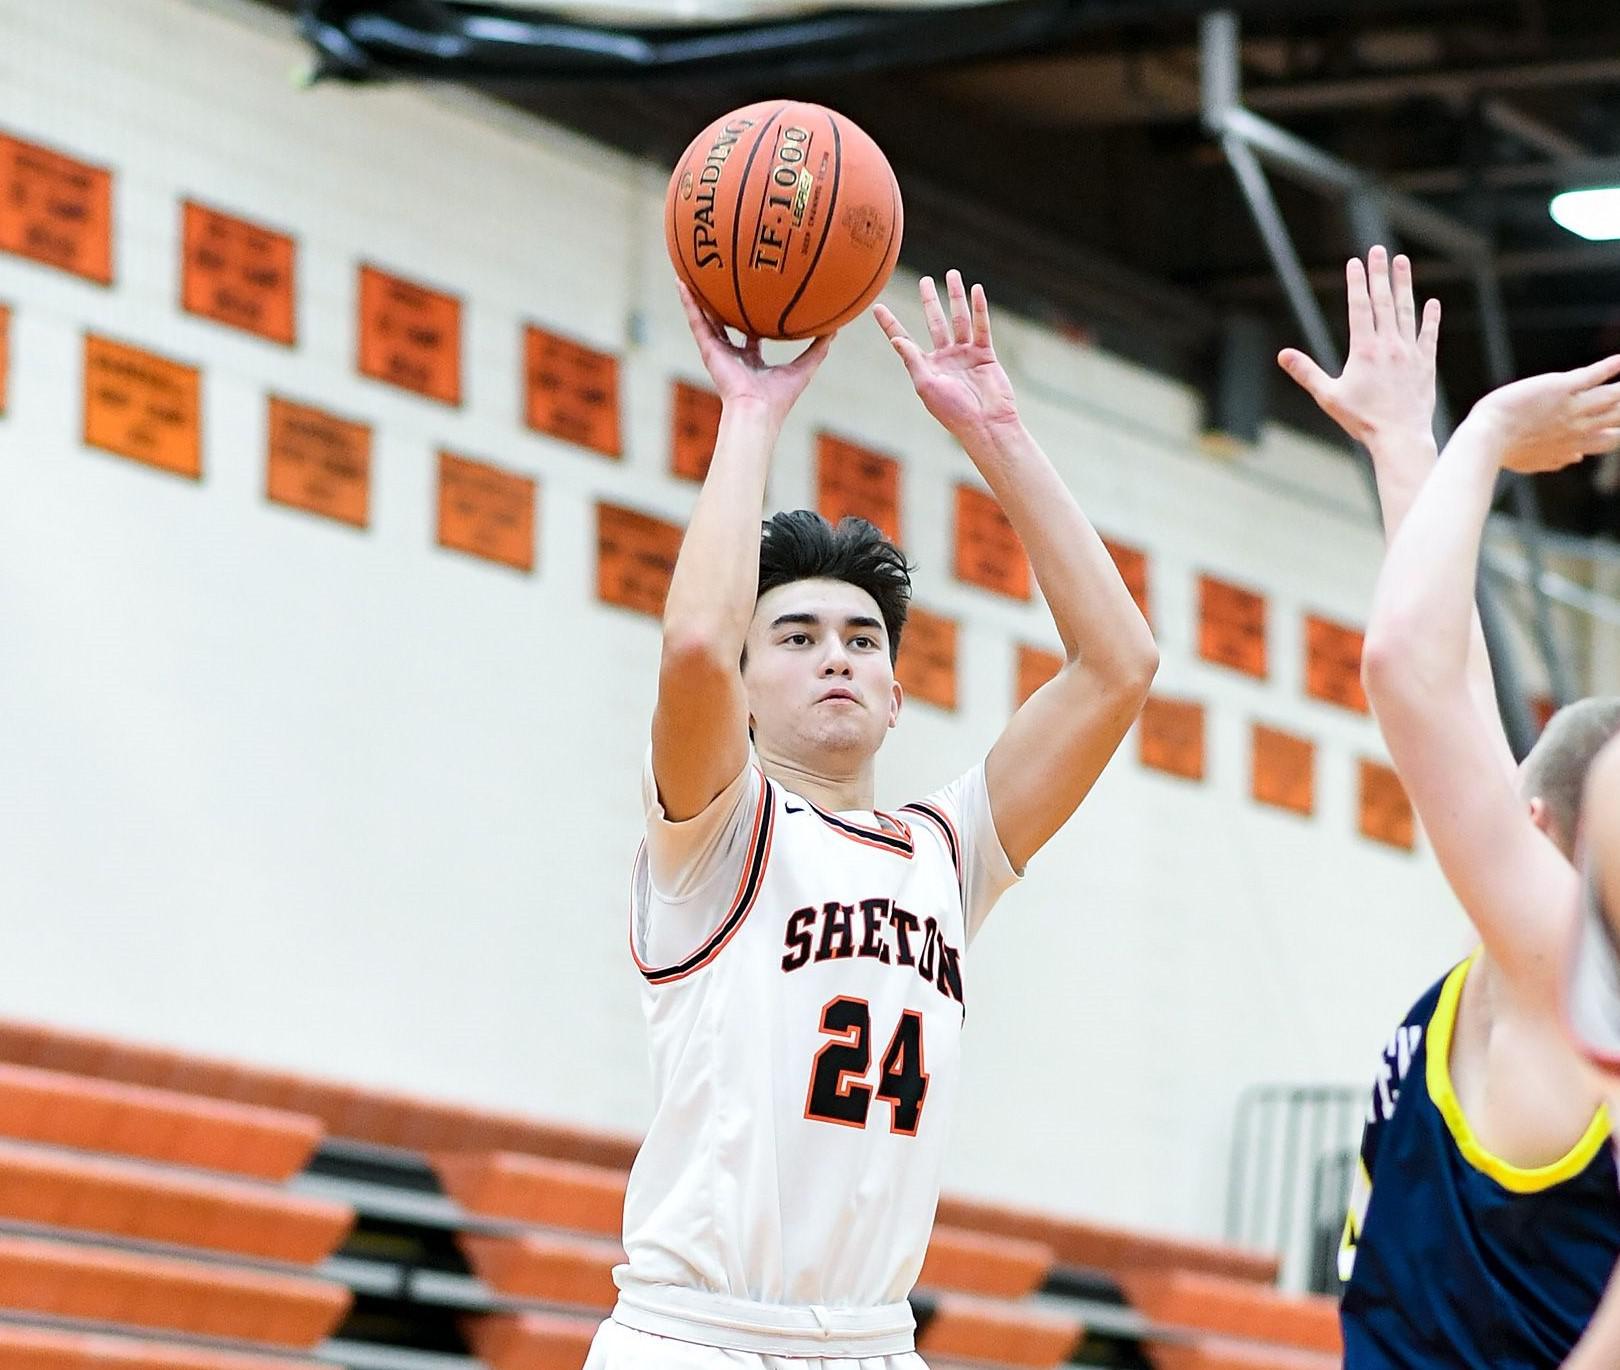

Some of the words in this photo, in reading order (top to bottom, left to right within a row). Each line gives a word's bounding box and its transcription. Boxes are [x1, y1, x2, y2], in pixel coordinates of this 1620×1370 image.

[693, 119, 754, 269] SPALDING
[781, 897, 966, 1005] SHETON
[803, 994, 931, 1138] 24
